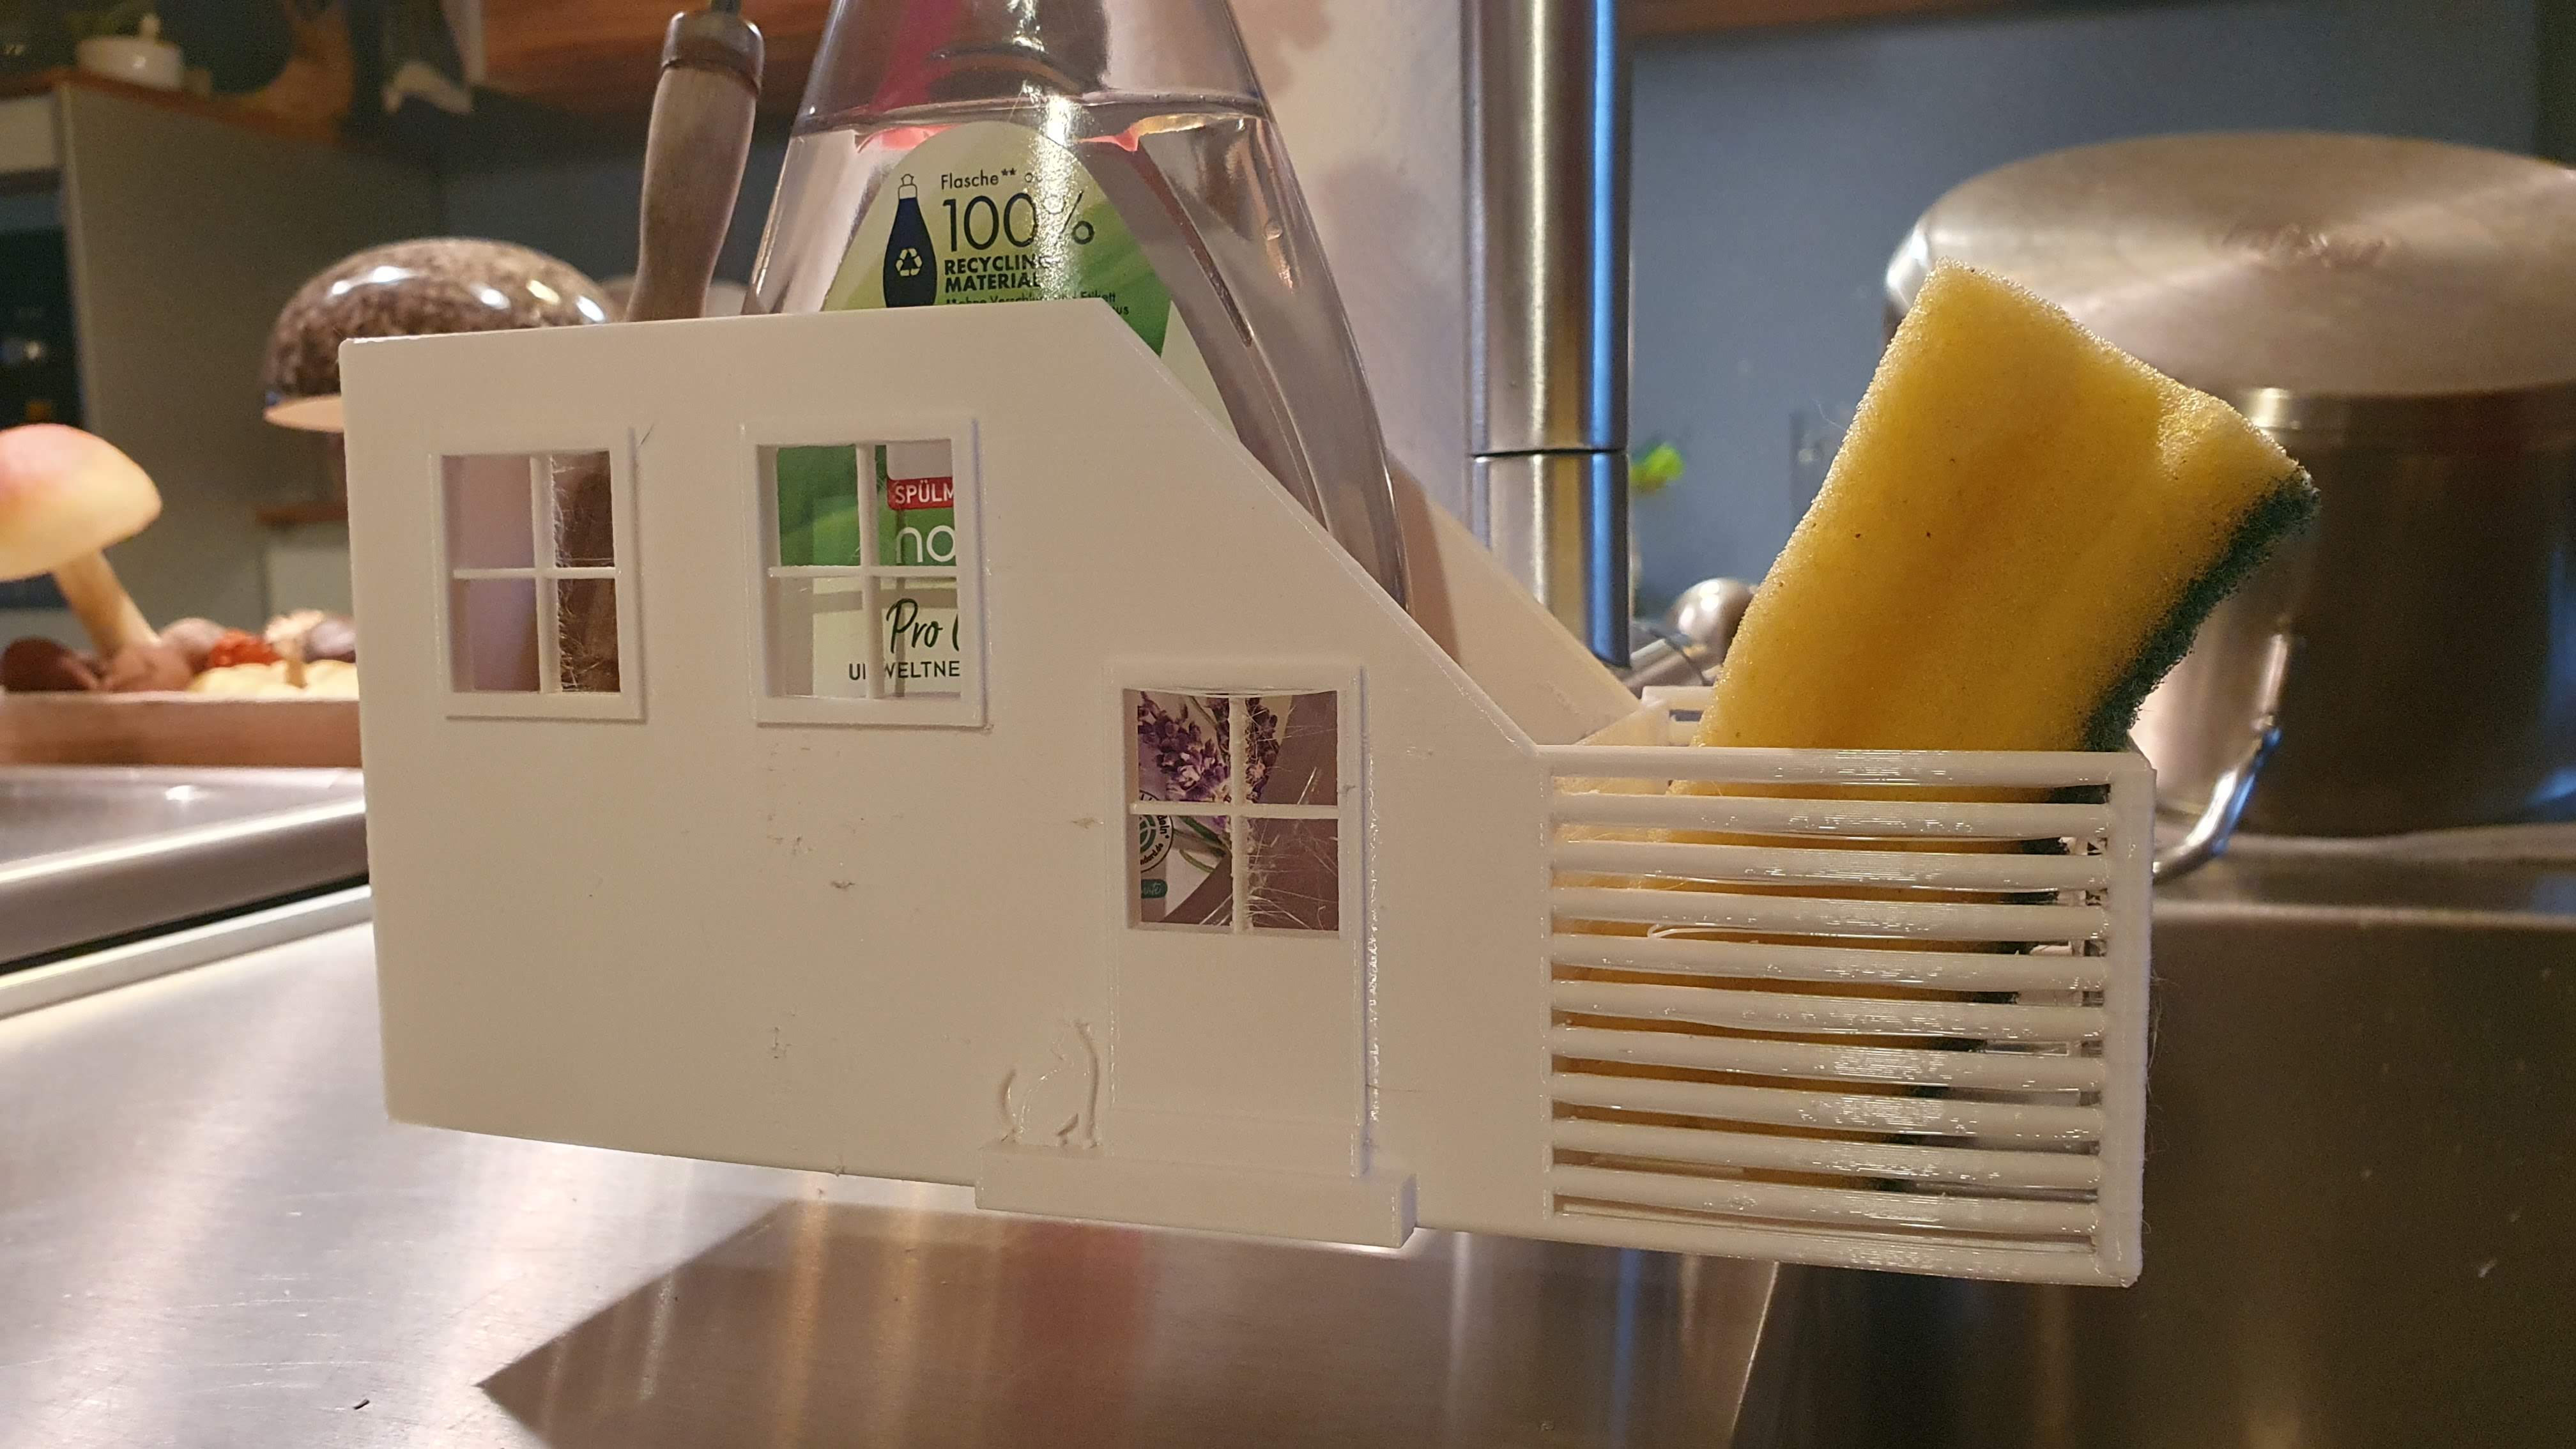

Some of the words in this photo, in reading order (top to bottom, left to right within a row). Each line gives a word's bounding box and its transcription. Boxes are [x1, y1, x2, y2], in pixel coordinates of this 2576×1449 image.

[942, 190, 1095, 252] 100%
[945, 273, 1041, 293] MATERIAL
[894, 479, 953, 504] SPÜLM
[886, 598, 943, 654] Pro
[848, 661, 960, 681] UWELTNE
